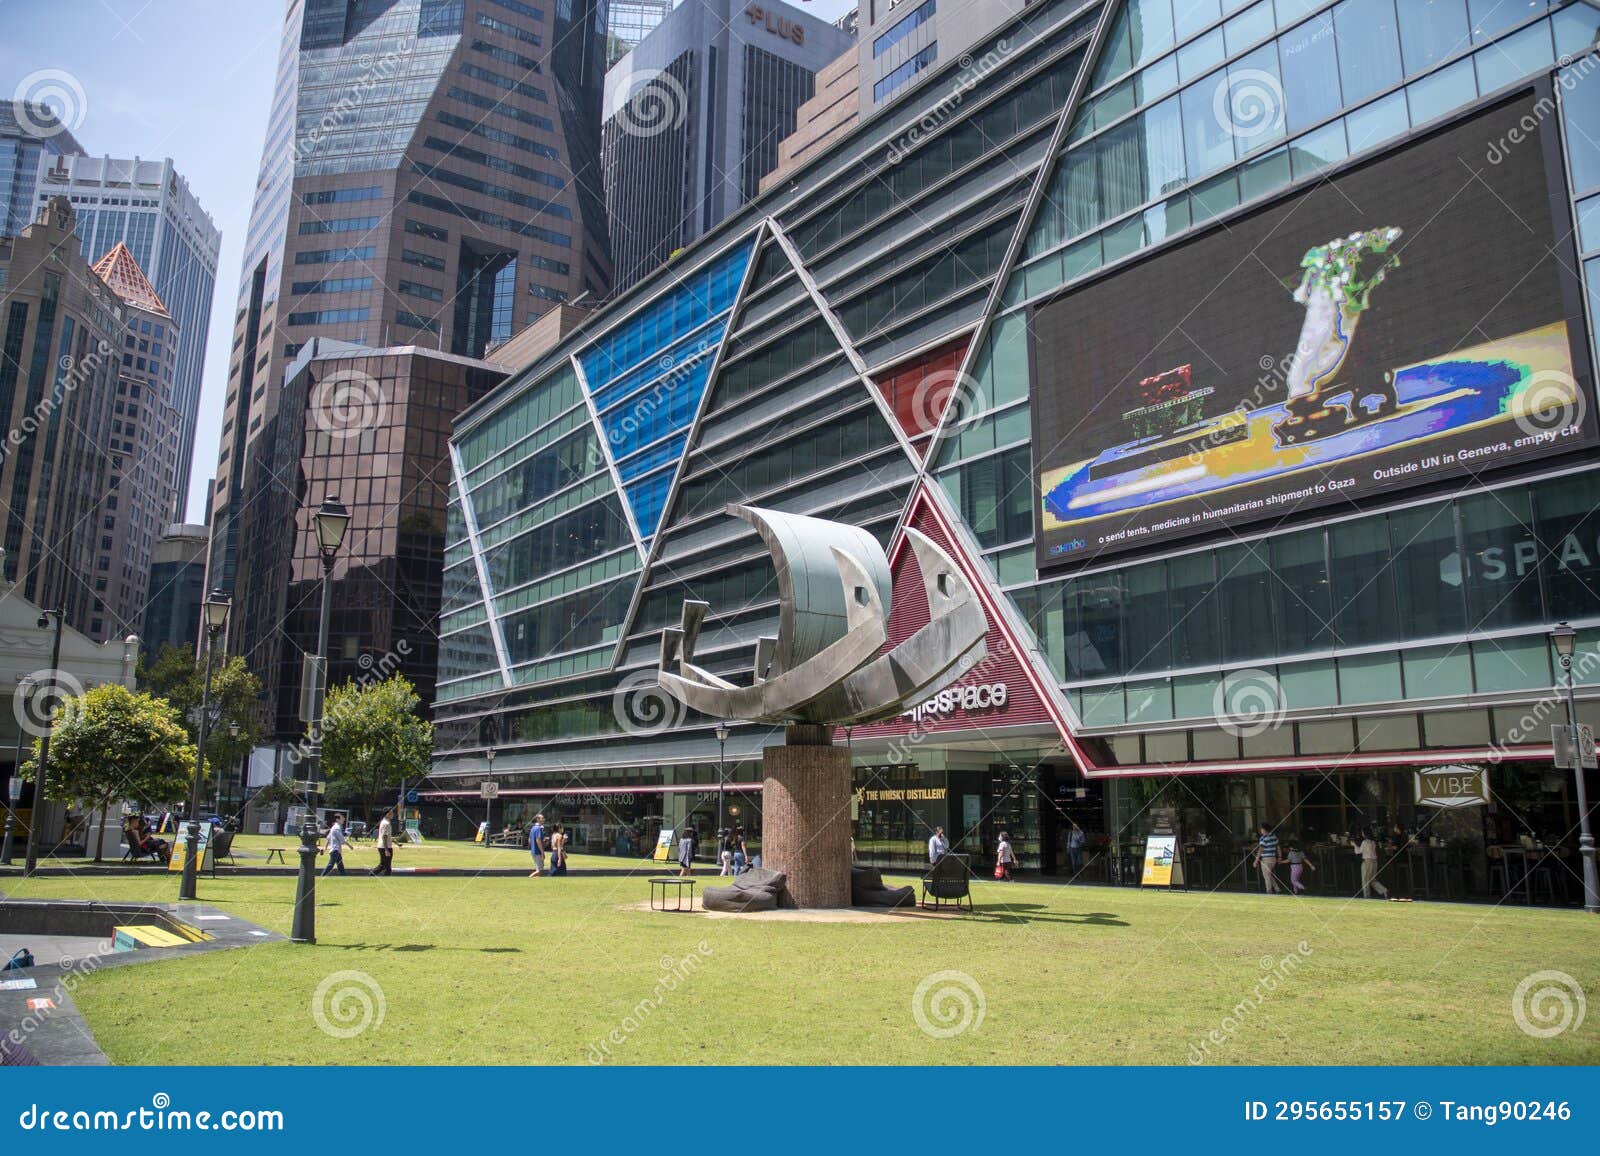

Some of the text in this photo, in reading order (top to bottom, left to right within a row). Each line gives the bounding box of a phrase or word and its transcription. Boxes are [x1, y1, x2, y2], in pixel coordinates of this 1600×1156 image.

[1373, 462, 1418, 480] Outside
[1421, 455, 1440, 469] UN
[1443, 453, 1455, 464] in
[1457, 442, 1511, 460] Geneva,
[1514, 431, 1557, 448] empty
[1105, 531, 1125, 543] send
[1127, 526, 1150, 537] tents,
[1151, 516, 1190, 531] medicine
[1192, 513, 1201, 522] in
[1203, 500, 1264, 520] humanitarian
[1265, 488, 1313, 505] shipment
[1315, 484, 1326, 494] to
[1328, 477, 1355, 490] Gaza
[866, 788, 947, 800] THE WHISKY DISTILLERY
[1426, 777, 1475, 795] VIBE
[613, 792, 634, 805] FOOD
